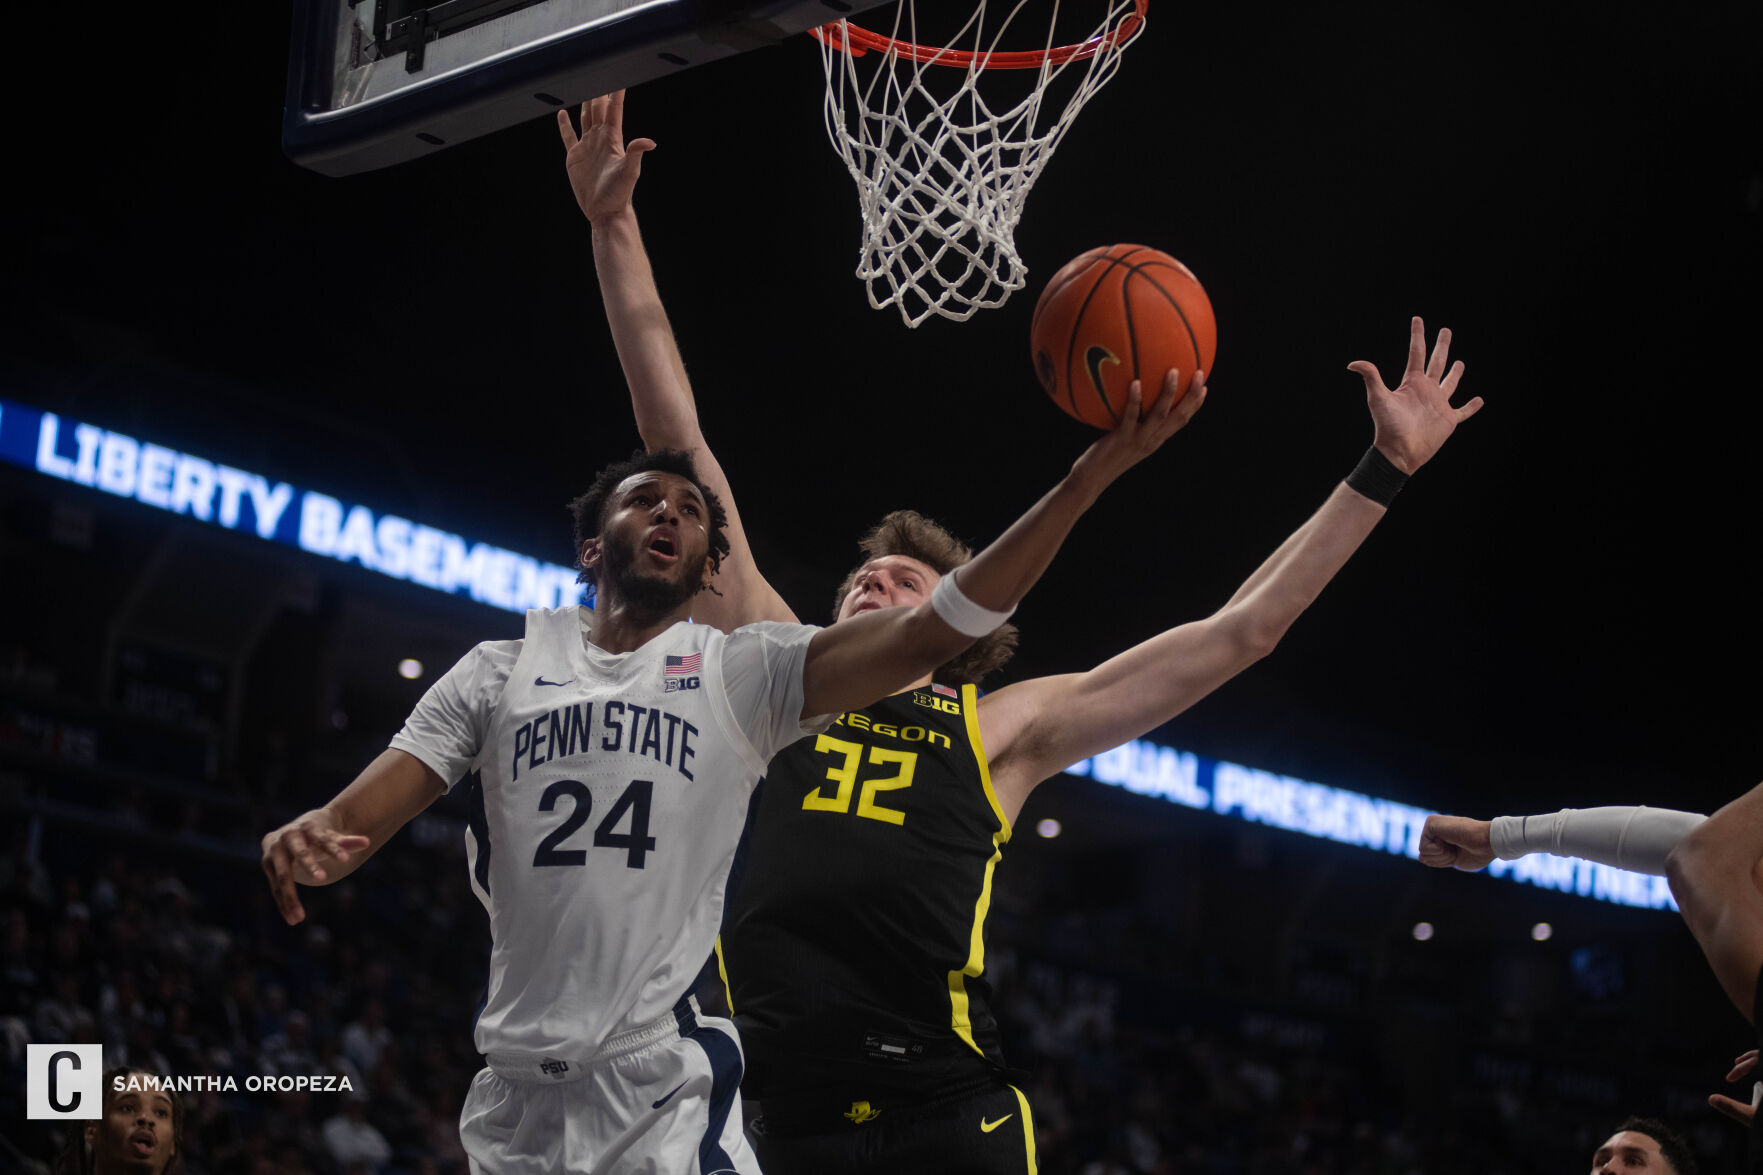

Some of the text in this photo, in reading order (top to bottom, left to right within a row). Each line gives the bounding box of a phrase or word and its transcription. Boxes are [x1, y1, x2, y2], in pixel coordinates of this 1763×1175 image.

[36, 411, 590, 616] LIBERTY BASEMENT
[512, 700, 699, 782] PENN STATE
[834, 713, 951, 749] EGON
[532, 779, 656, 869] 24
[802, 733, 918, 826] 32
[1213, 760, 1432, 859] PRESENT
[540, 1061, 569, 1075] PSU
